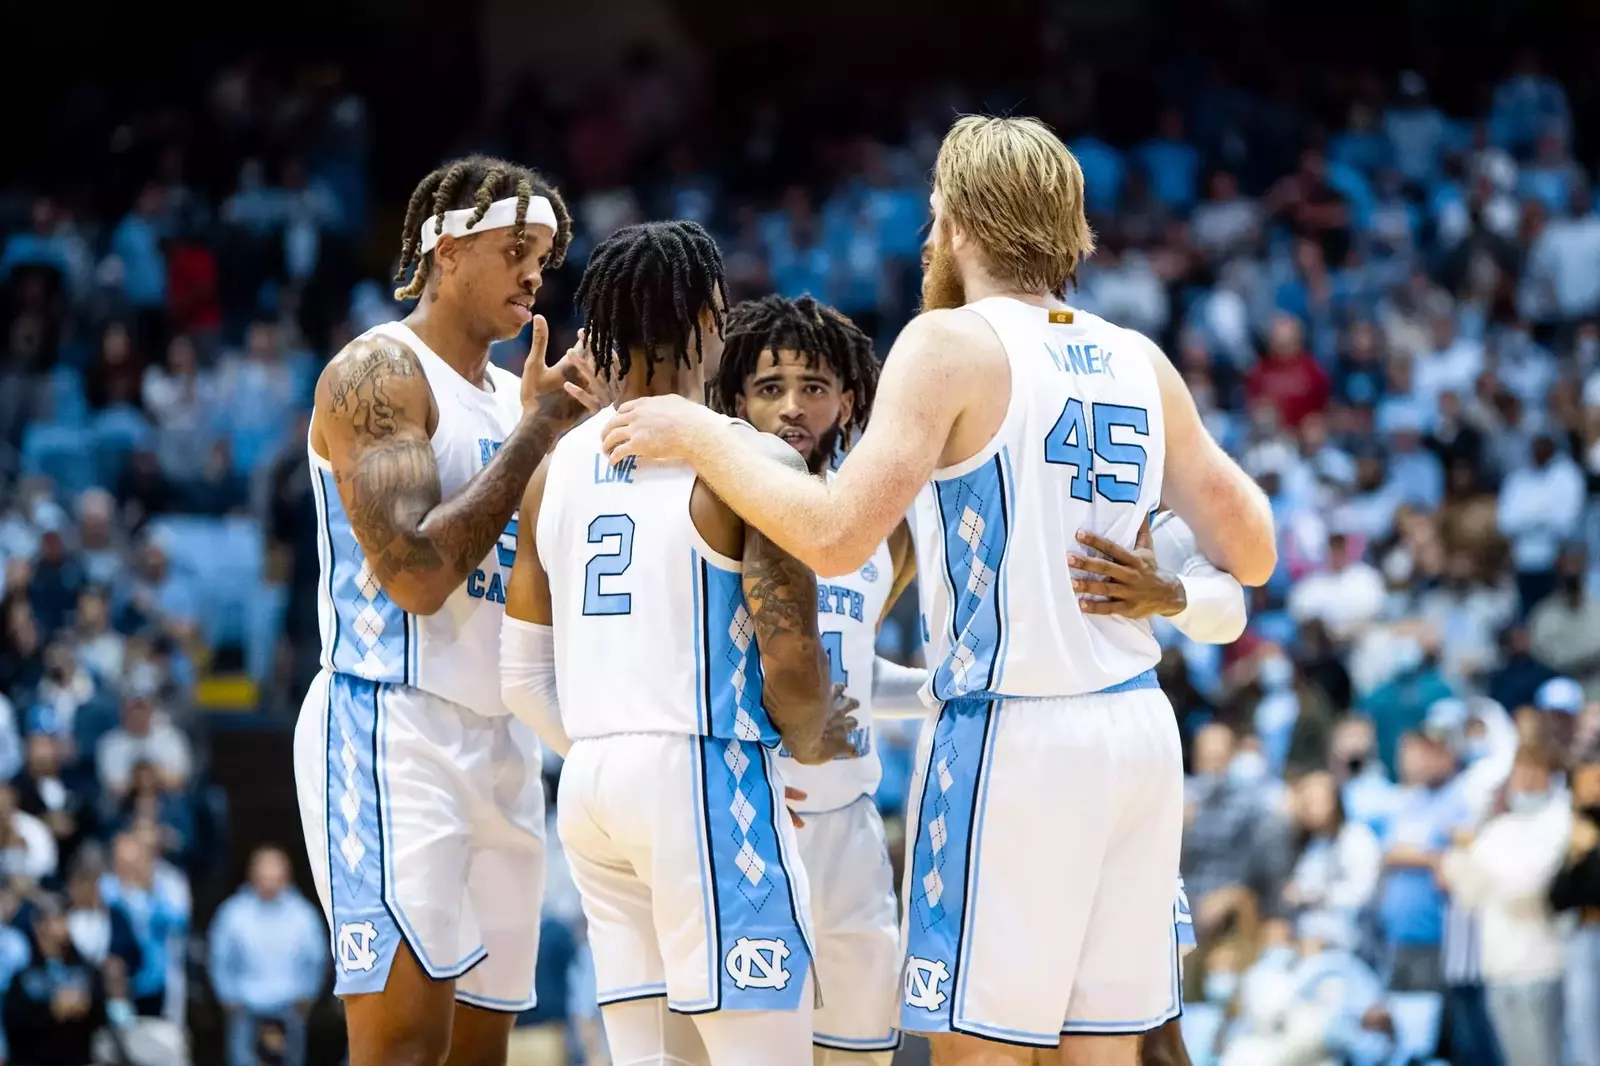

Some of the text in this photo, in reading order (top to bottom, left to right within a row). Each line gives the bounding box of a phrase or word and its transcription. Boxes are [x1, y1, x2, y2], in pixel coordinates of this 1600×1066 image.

[594, 453, 637, 484] LOVE
[1044, 397, 1149, 504] 45
[582, 514, 635, 616] 2
[817, 584, 865, 623] RTH
